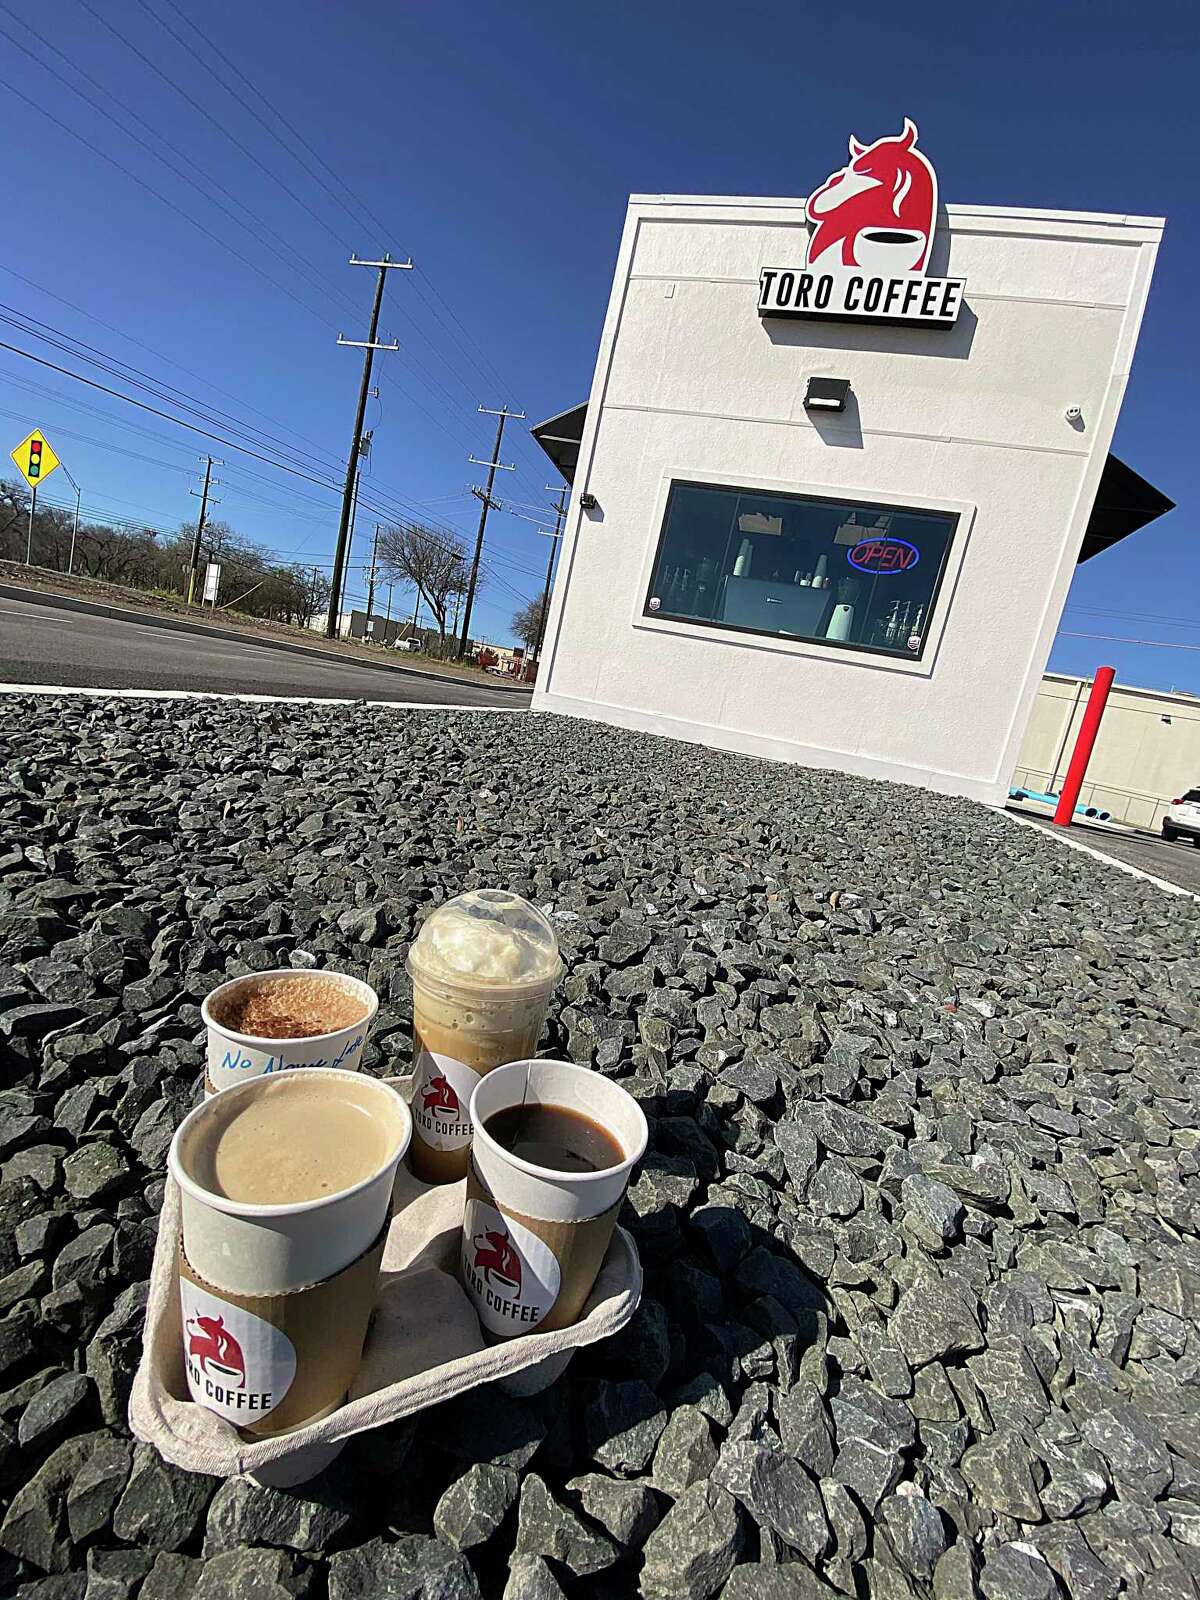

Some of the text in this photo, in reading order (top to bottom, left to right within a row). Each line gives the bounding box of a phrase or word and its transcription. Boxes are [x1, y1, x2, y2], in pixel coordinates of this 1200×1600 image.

[761, 271, 961, 318] TORO COFFEE
[851, 541, 914, 569] OPEN
[221, 1049, 252, 1069] No
[415, 1108, 432, 1130] TORO
[464, 1254, 540, 1323] TORO COFFEE
[205, 1379, 272, 1410] COFFEE
